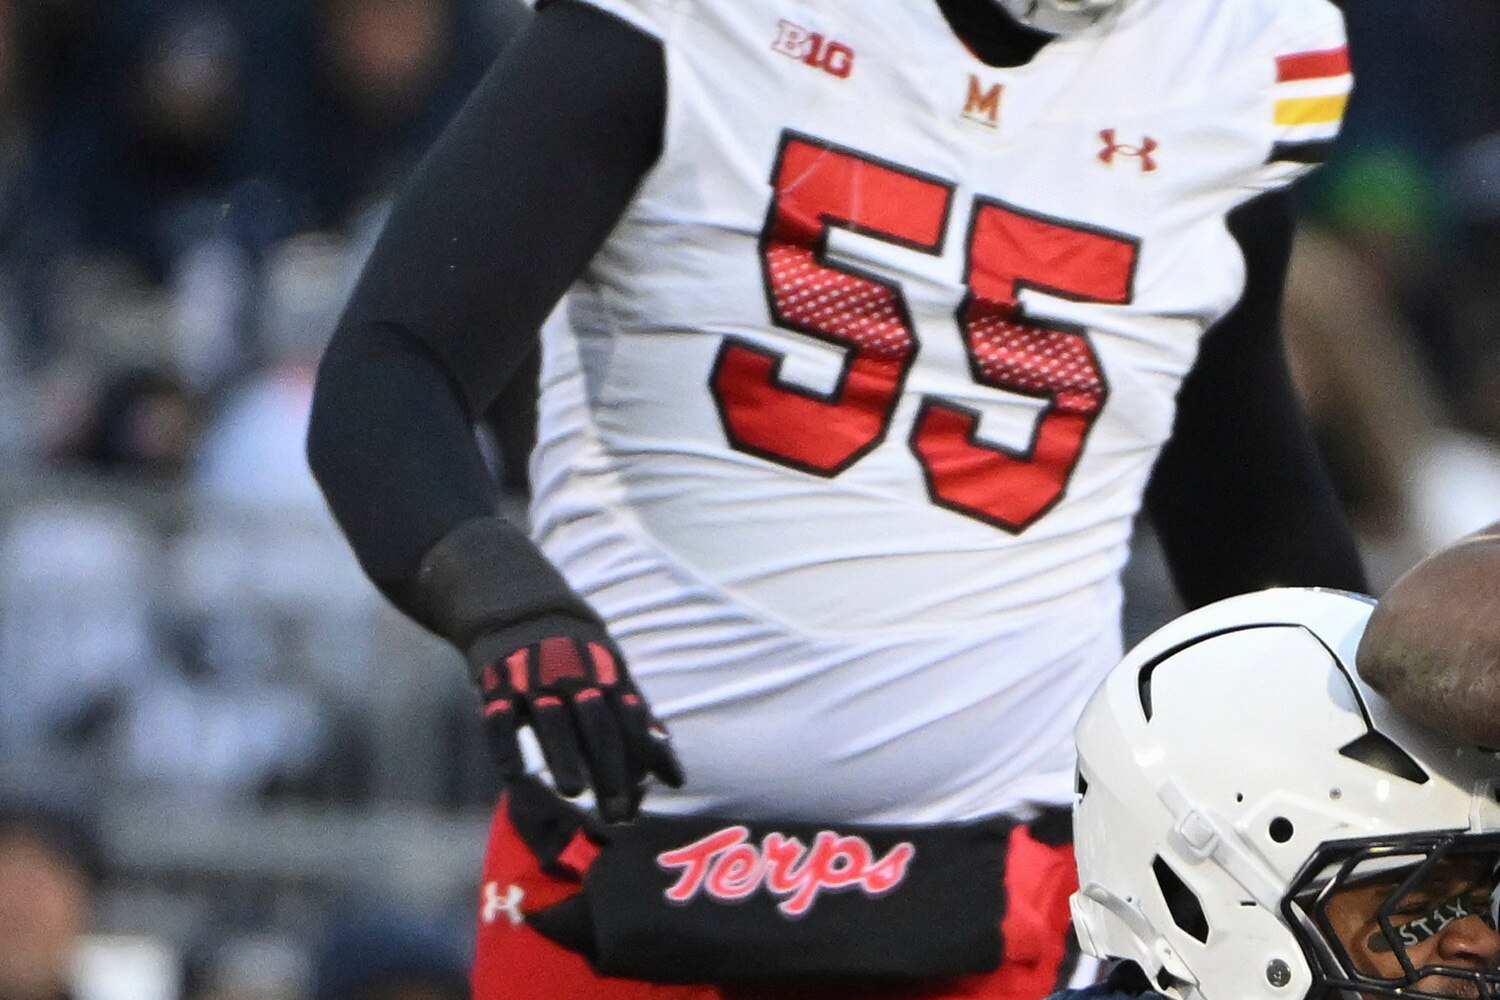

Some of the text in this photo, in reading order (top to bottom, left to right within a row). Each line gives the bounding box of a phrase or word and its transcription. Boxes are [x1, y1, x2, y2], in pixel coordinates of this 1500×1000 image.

[962, 73, 1003, 125] M
[709, 127, 1142, 535] 55
[656, 824, 916, 916] Terps
